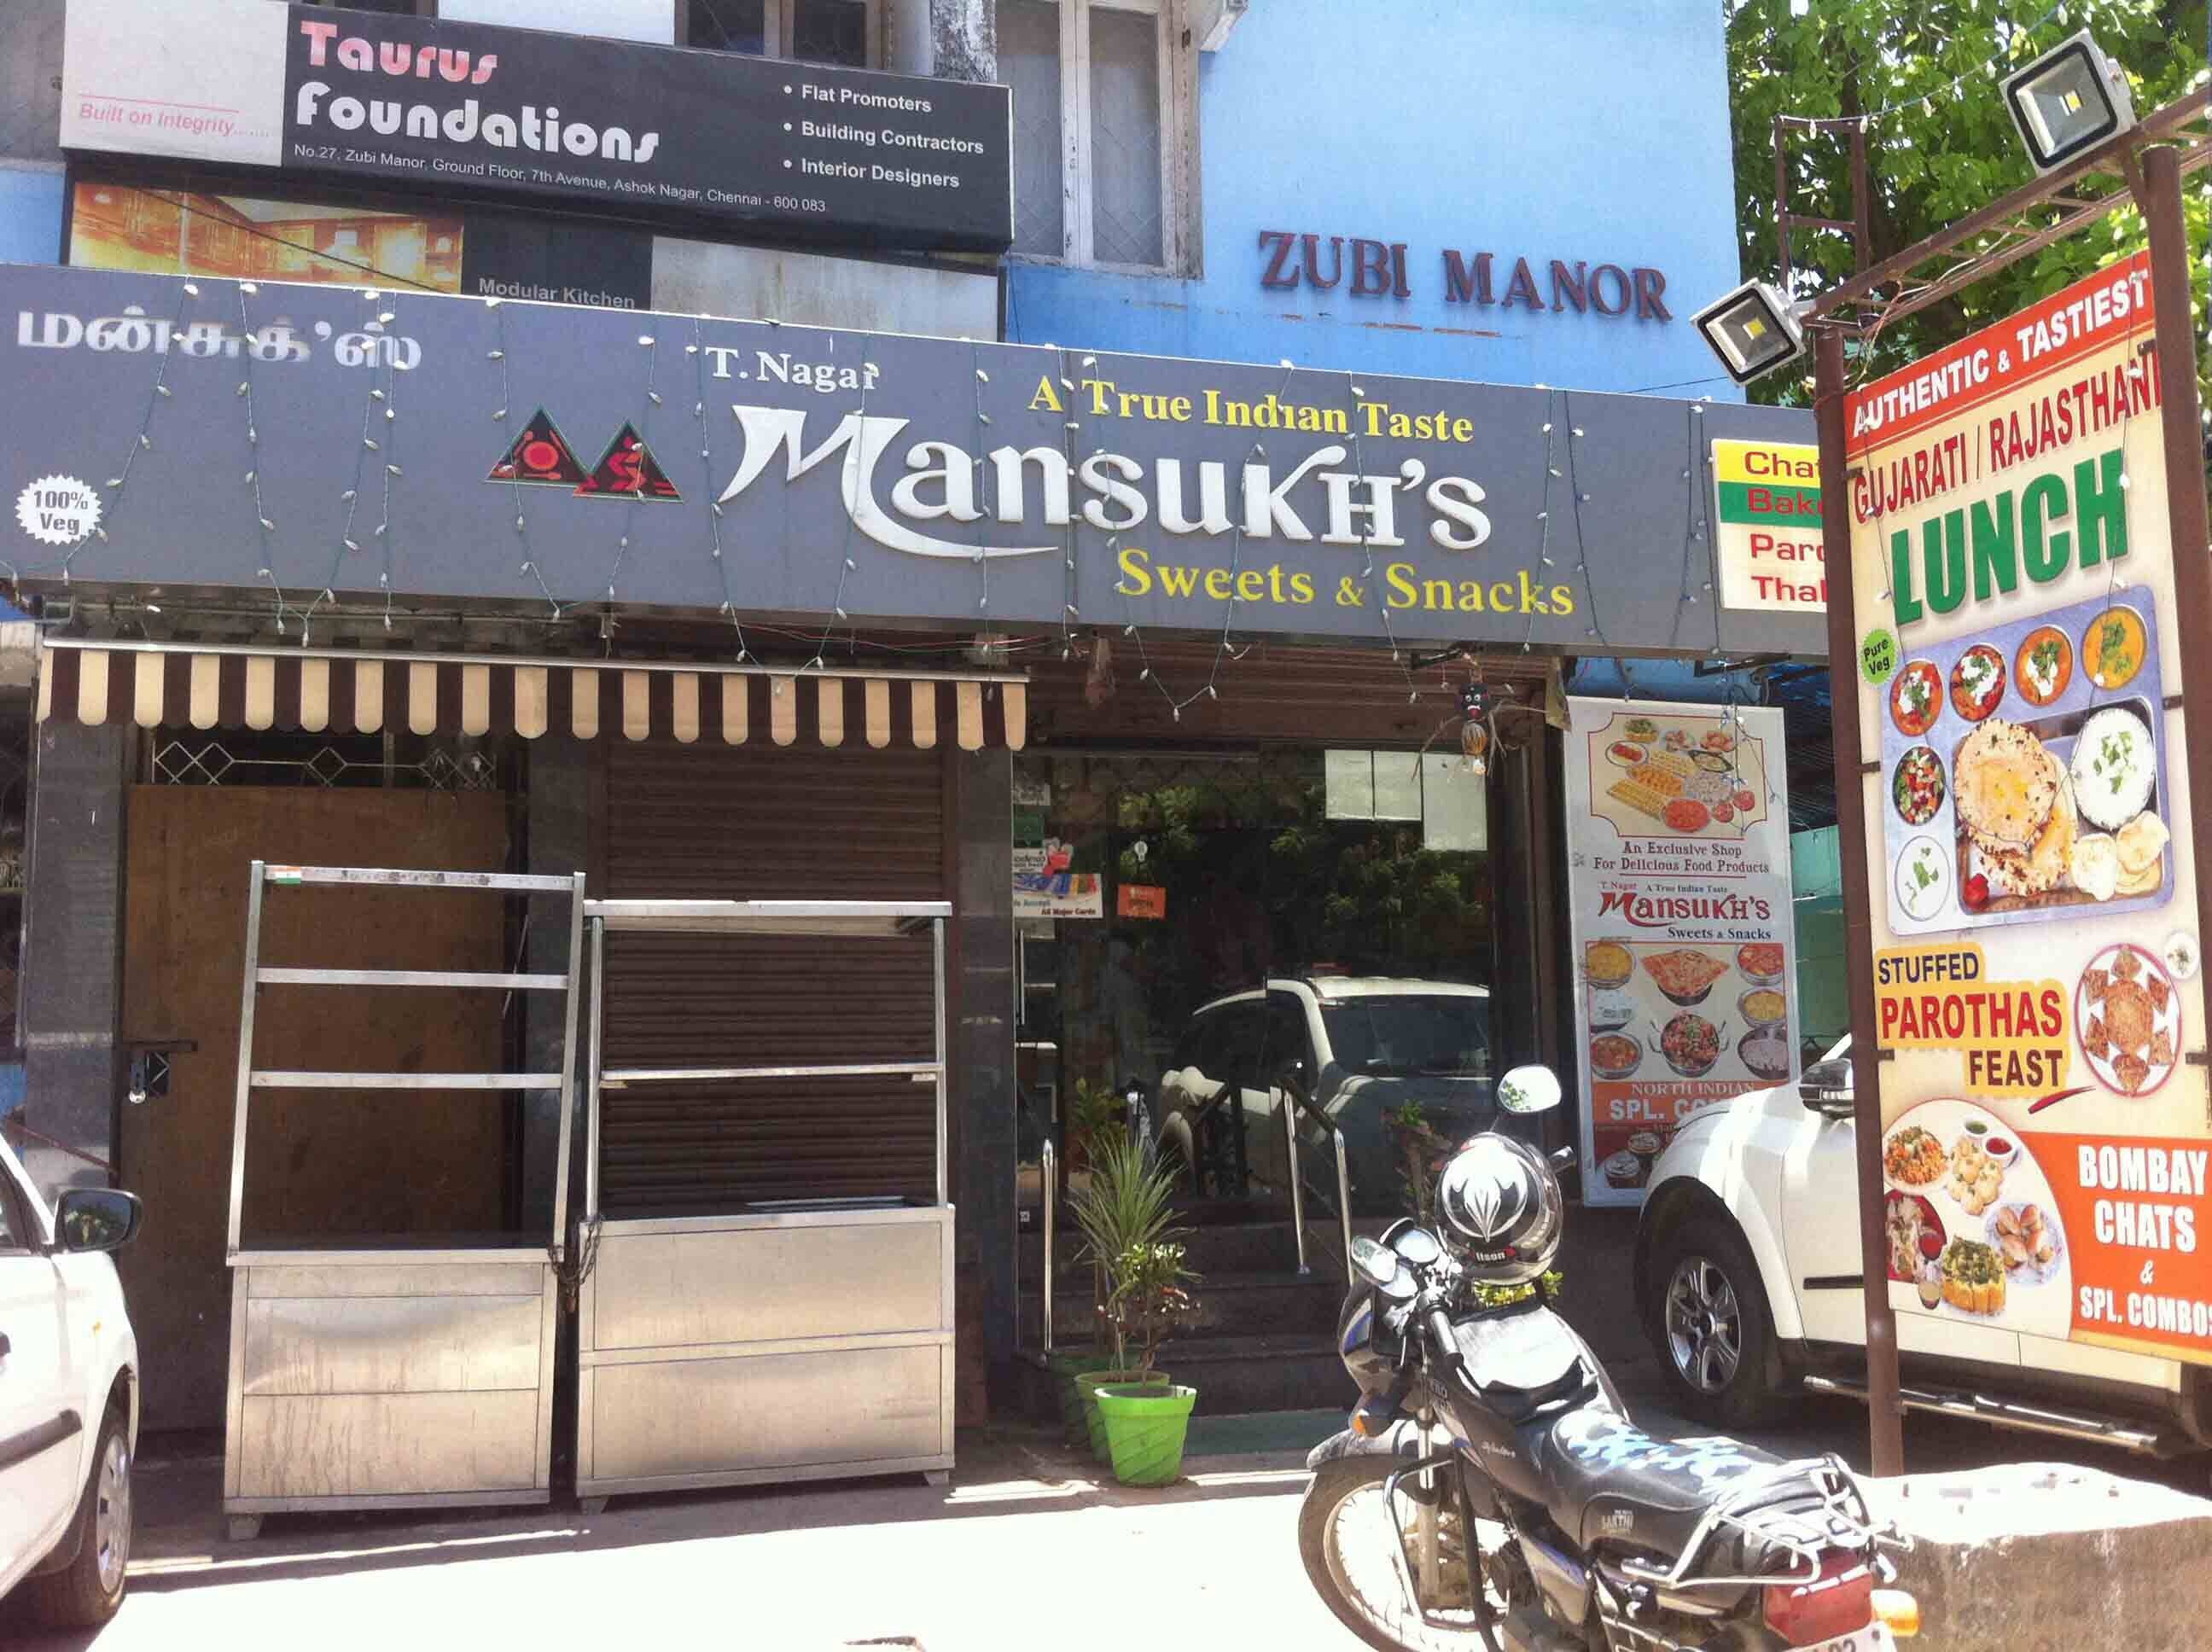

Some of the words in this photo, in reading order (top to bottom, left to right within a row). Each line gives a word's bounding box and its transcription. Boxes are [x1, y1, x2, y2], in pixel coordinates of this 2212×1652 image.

[300, 20, 498, 84] Taurus
[79, 103, 123, 122] Built
[129, 111, 153, 125] on
[801, 84, 836, 102] Flat
[840, 88, 933, 113] Promoters
[295, 81, 661, 164] Foundations
[800, 121, 876, 146] Building
[881, 130, 985, 155] Contractors
[345, 149, 376, 164] Zubi
[433, 158, 484, 176] Ground
[533, 169, 552, 183] 7th
[614, 177, 655, 195] Ashok
[707, 189, 762, 206] Chennai
[801, 197, 826, 212] 083
[801, 158, 866, 179] Interior
[871, 166, 960, 189] Designers
[479, 277, 557, 301] Modular
[563, 287, 635, 309] Kitchen
[1259, 230, 1412, 299] ZUBI
[1442, 249, 1674, 322] MANOR
[1853, 348, 1991, 438] AUTHENTIC
[1997, 348, 2011, 374] &
[2017, 268, 2150, 363] TASTIEST
[1028, 375, 1064, 412] A
[1081, 379, 1192, 423] True
[1202, 390, 1348, 435] Indian
[1357, 402, 1475, 443] Taste
[1853, 432, 1968, 525] GUJARATI
[1989, 345, 2163, 474] RAJASTHANI
[1744, 451, 1821, 480] Cha
[32, 490, 89, 510] 100%
[38, 514, 80, 536] Veg
[1891, 448, 2128, 626] LUNCH
[1118, 549, 1315, 604] Sweets
[1336, 577, 1365, 607] &
[1386, 563, 1575, 616] Snacks
[1863, 638, 1889, 663] Pure
[1868, 655, 1890, 676] Veg
[1594, 857, 1616, 870] For
[1621, 858, 1679, 871] Delicious
[1684, 858, 1713, 872] Food
[1717, 860, 1769, 874] Products
[1623, 841, 1641, 854] An
[1647, 841, 1707, 855] Exclusive
[1712, 843, 1742, 858] Shop
[1668, 927, 1714, 939] Sweets
[1727, 928, 1772, 939] Snacks
[1877, 951, 1980, 985] STUFFED
[1881, 989, 2064, 1039] PAROTHAS
[1969, 1049, 2064, 1088] FEAST
[1632, 1082, 1689, 1096] NORTH
[1698, 1083, 1754, 1096] INDIAN
[2077, 1143, 2209, 1196] BOMBAY
[2094, 1198, 2197, 1254] CHATS
[2139, 1259, 2155, 1286] &
[2079, 1285, 2124, 1324] SPL.
